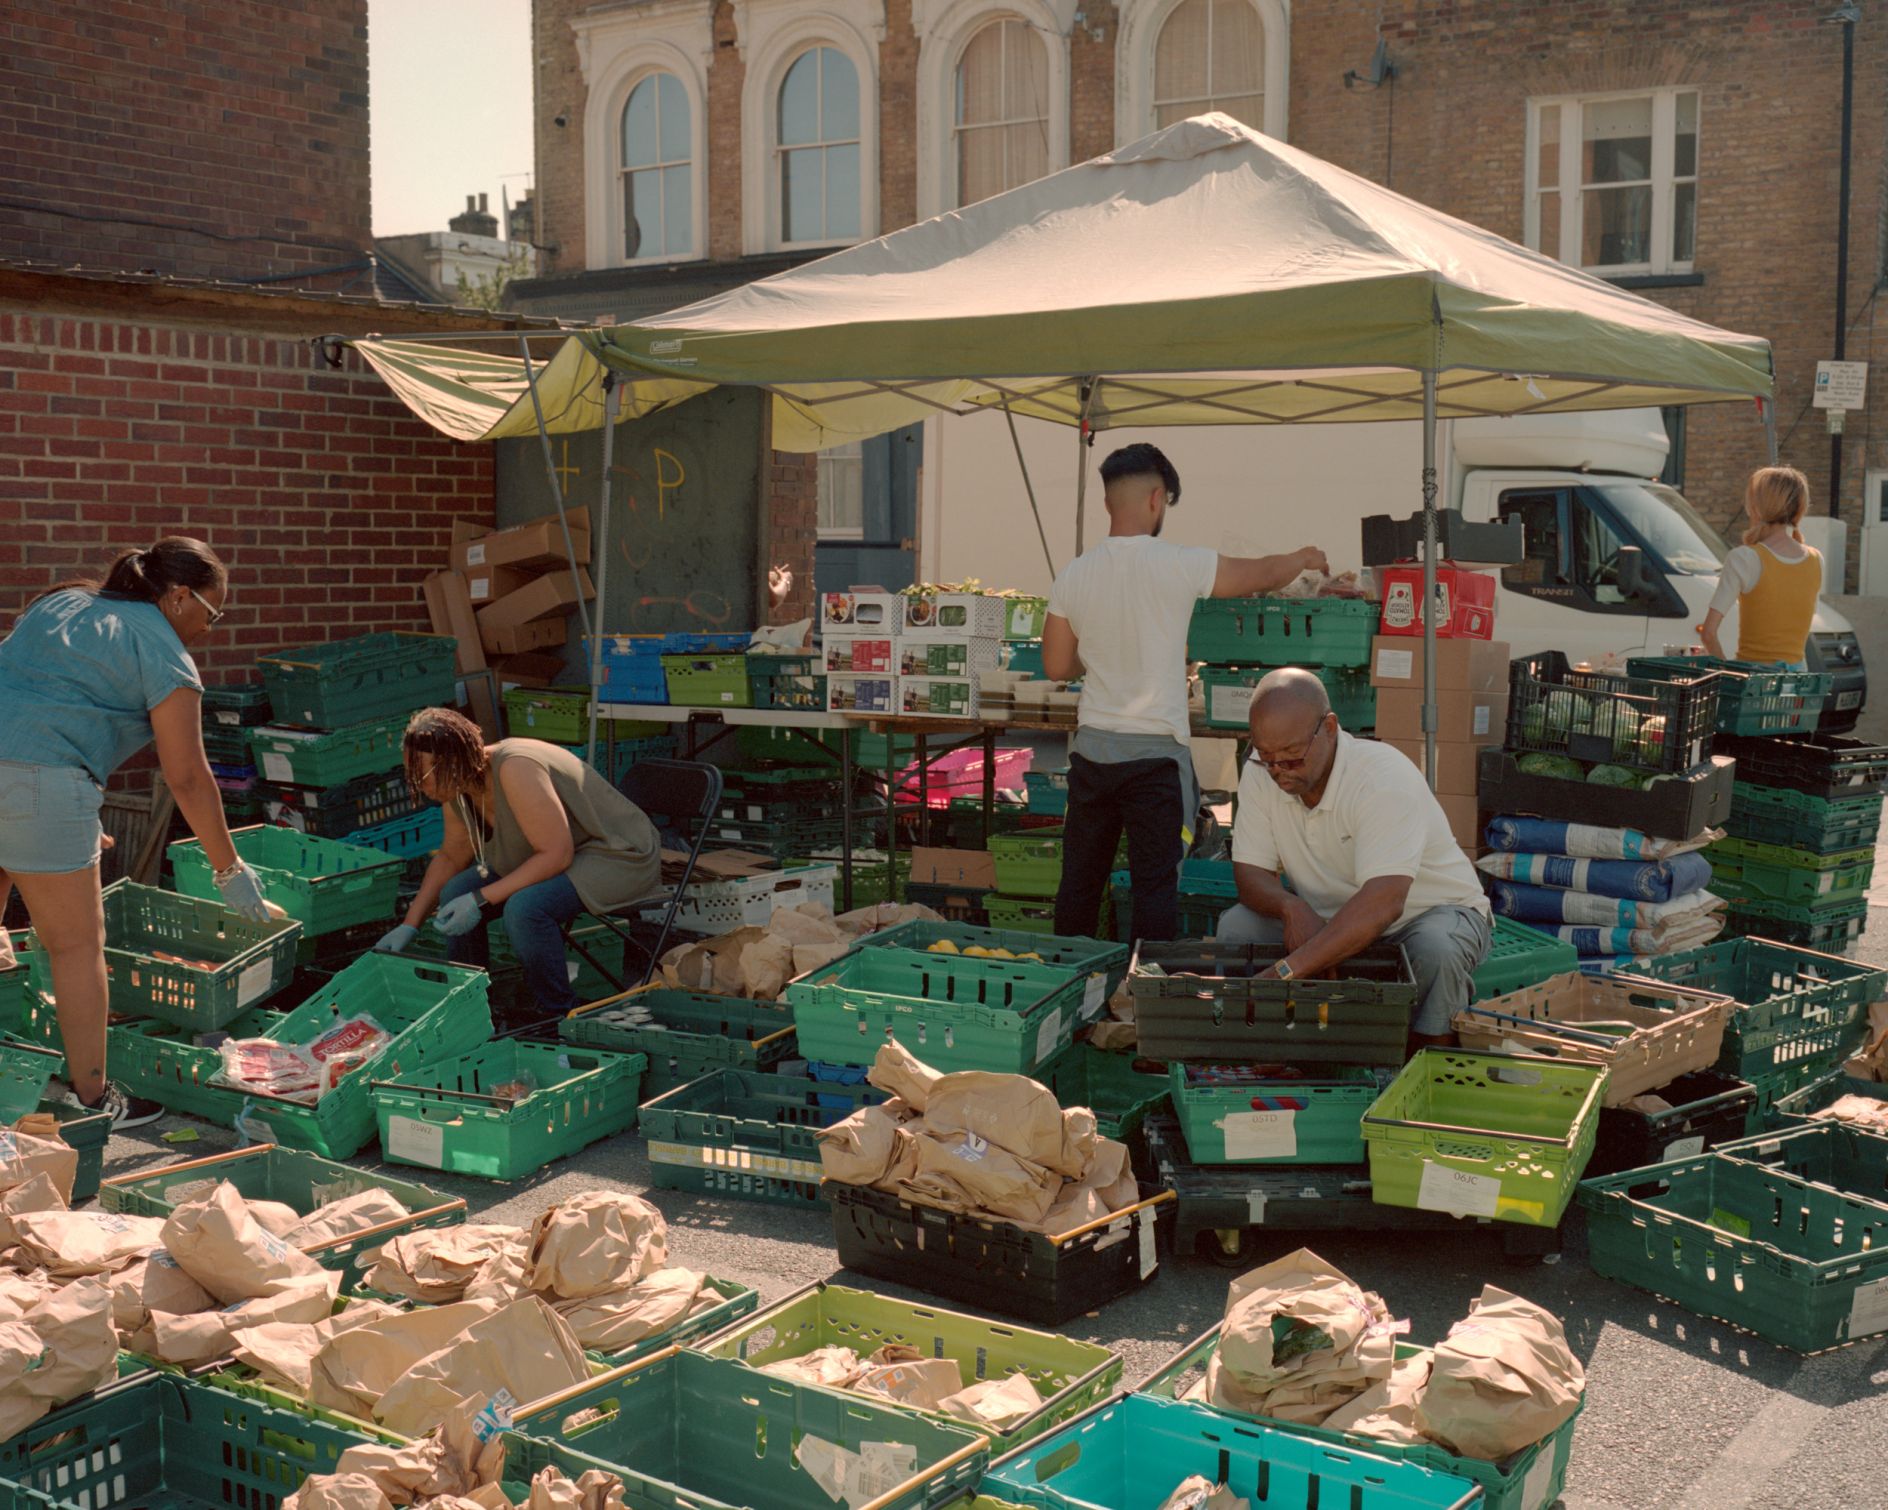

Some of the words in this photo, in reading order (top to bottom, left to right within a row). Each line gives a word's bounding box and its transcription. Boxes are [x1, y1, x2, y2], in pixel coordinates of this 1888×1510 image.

[653, 447, 685, 520] P
[321, 1028, 367, 1055] TORTILLA
[1454, 1172, 1478, 1186] 06JC
